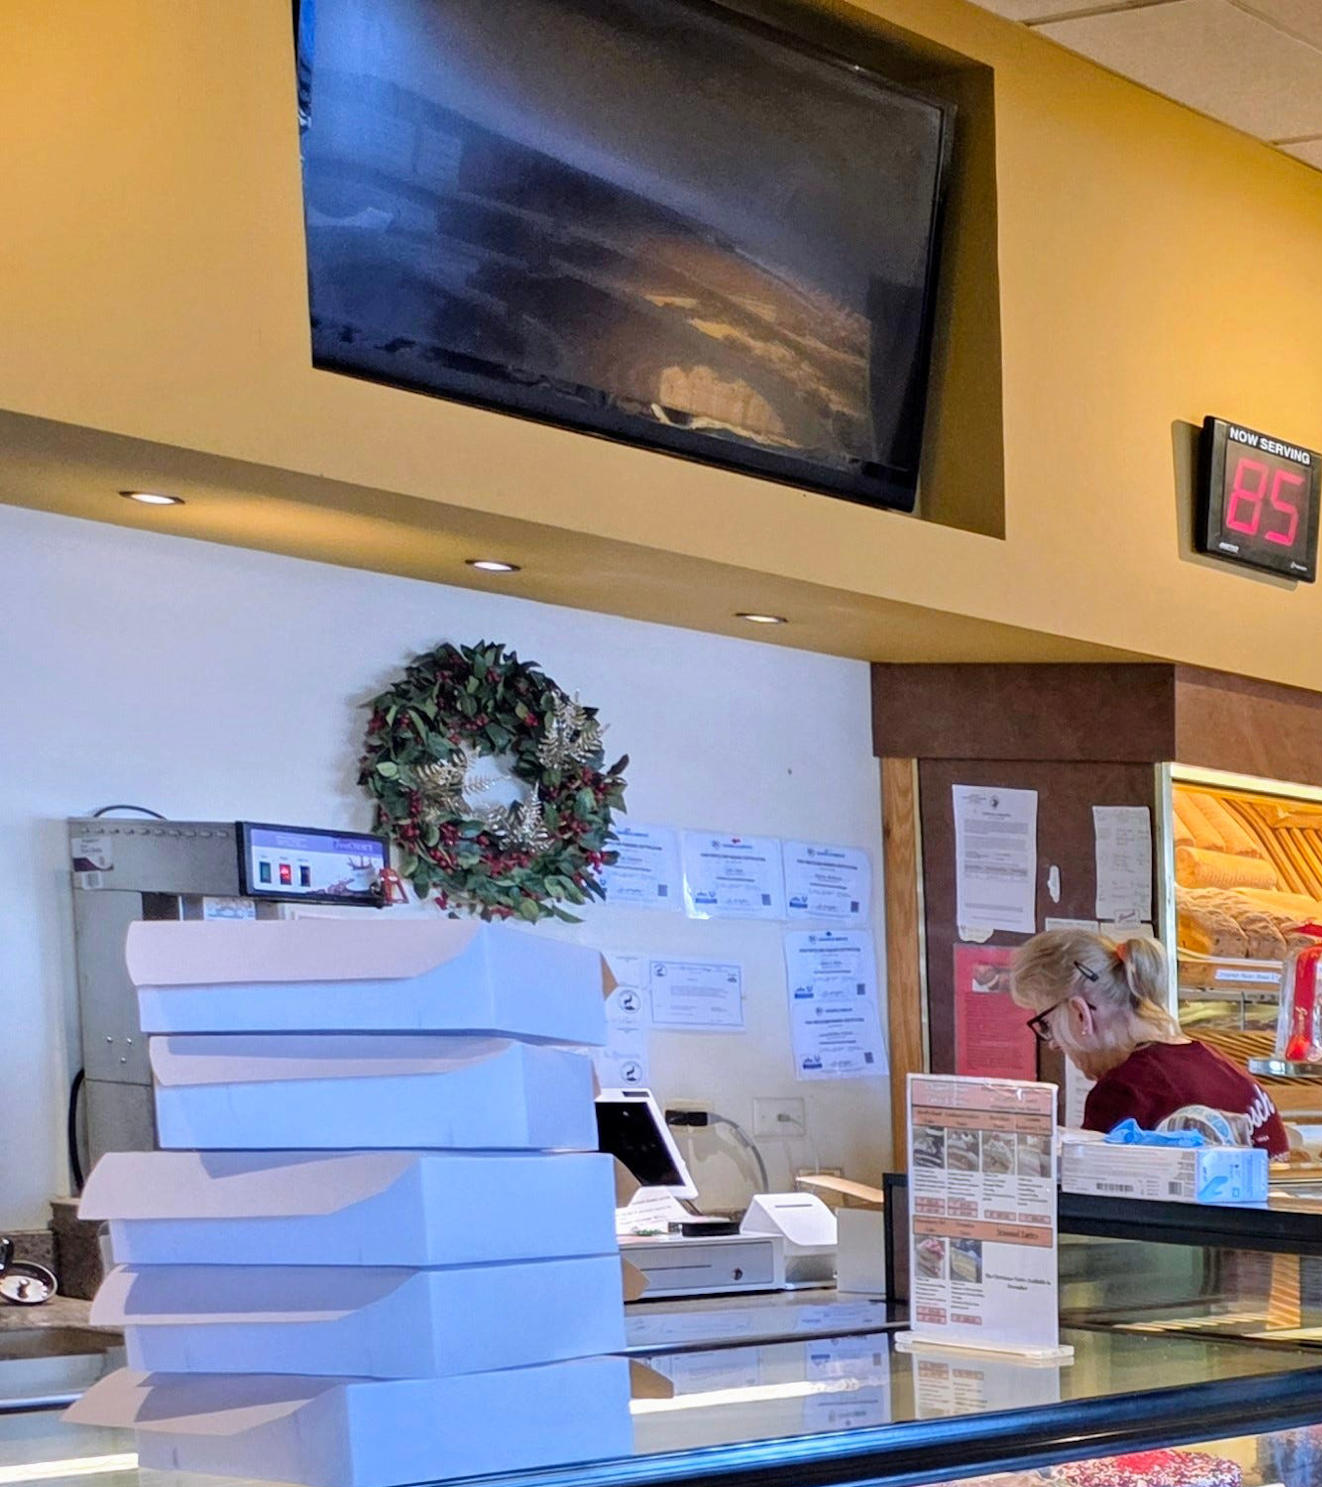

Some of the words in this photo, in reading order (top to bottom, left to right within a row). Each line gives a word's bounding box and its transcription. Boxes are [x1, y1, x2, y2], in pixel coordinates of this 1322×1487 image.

[1229, 426, 1258, 448] NOW
[1260, 437, 1312, 466] SERVING
[1226, 457, 1305, 547] 85
